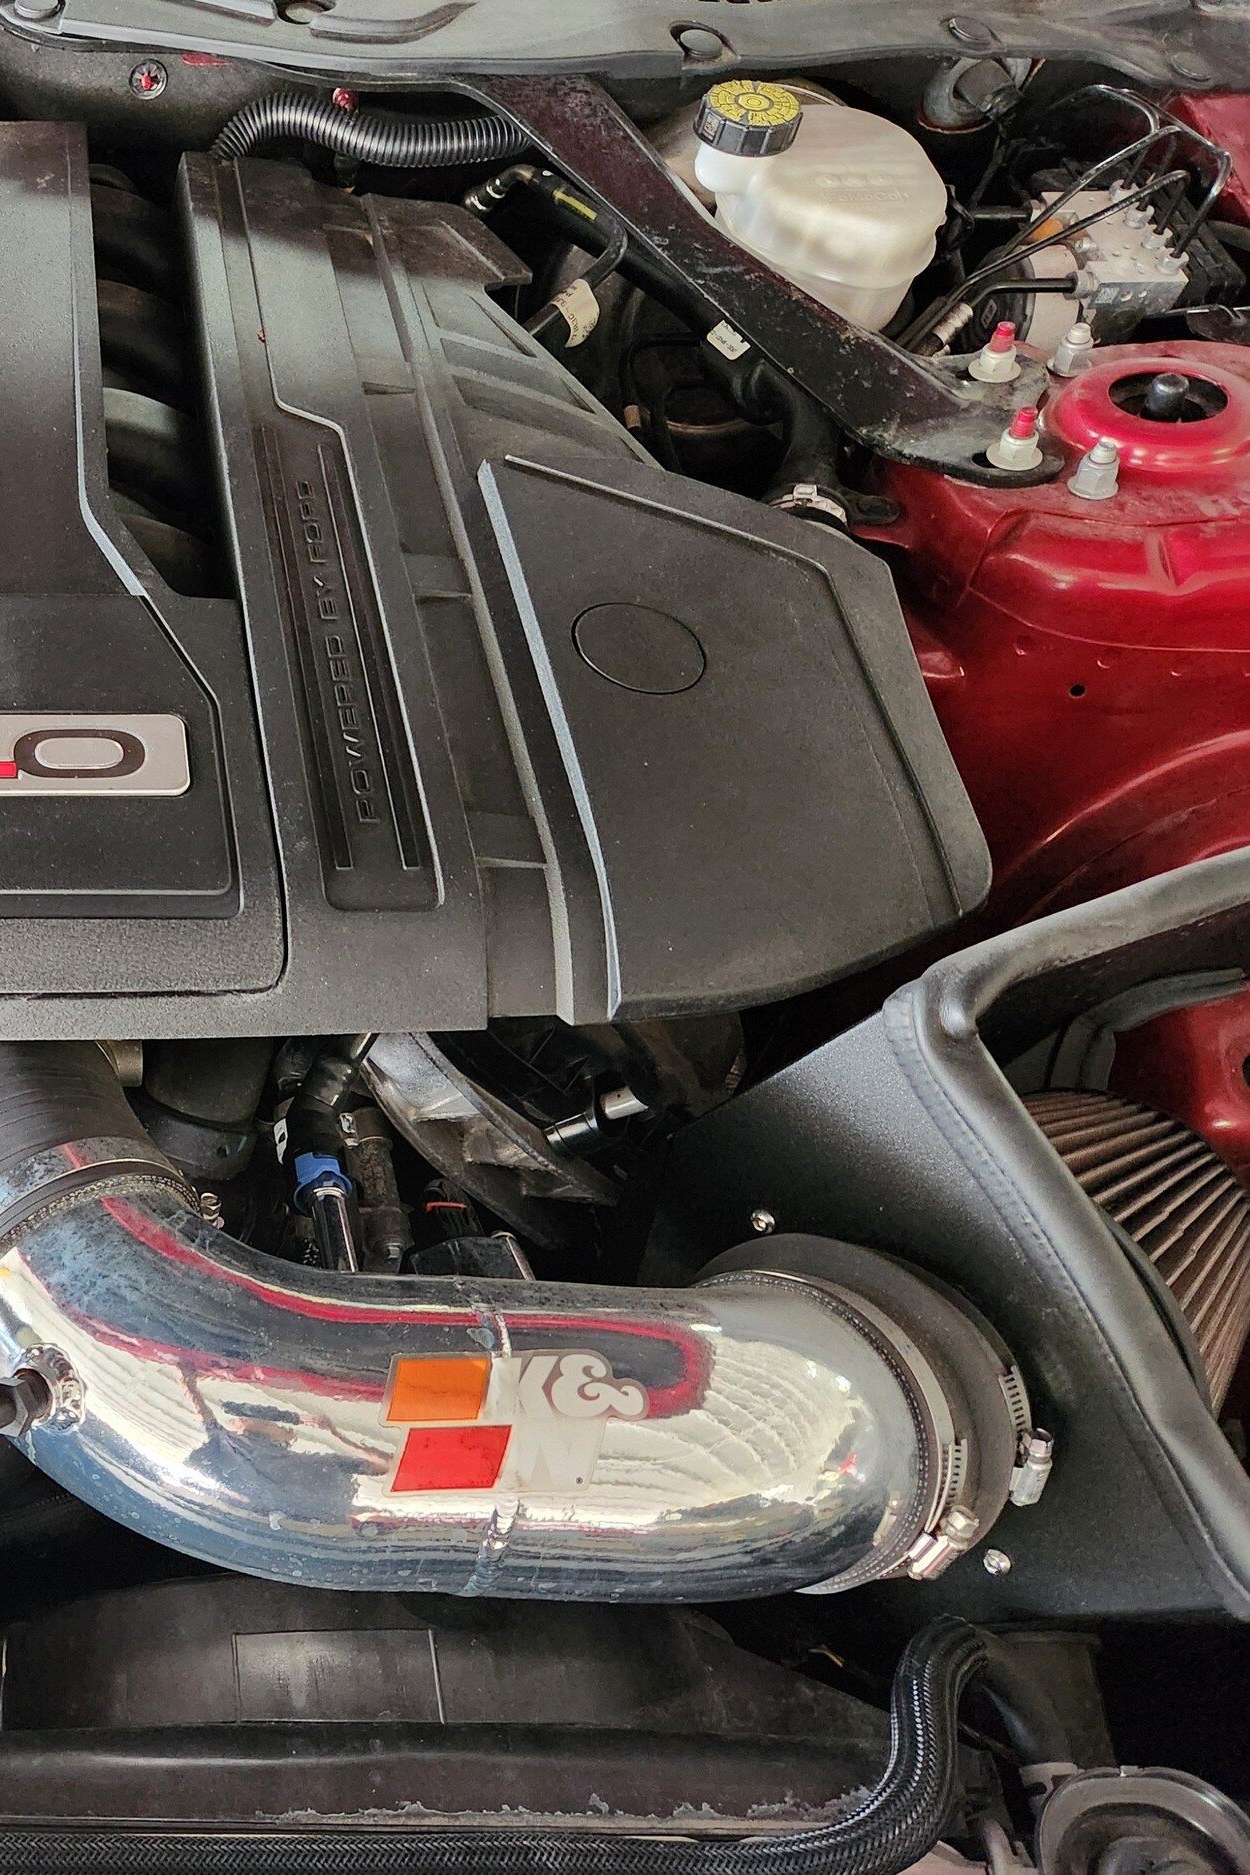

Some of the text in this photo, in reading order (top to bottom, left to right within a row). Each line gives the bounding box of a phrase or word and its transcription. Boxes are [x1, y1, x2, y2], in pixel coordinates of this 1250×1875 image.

[295, 480, 381, 823] POWERED BY FORD
